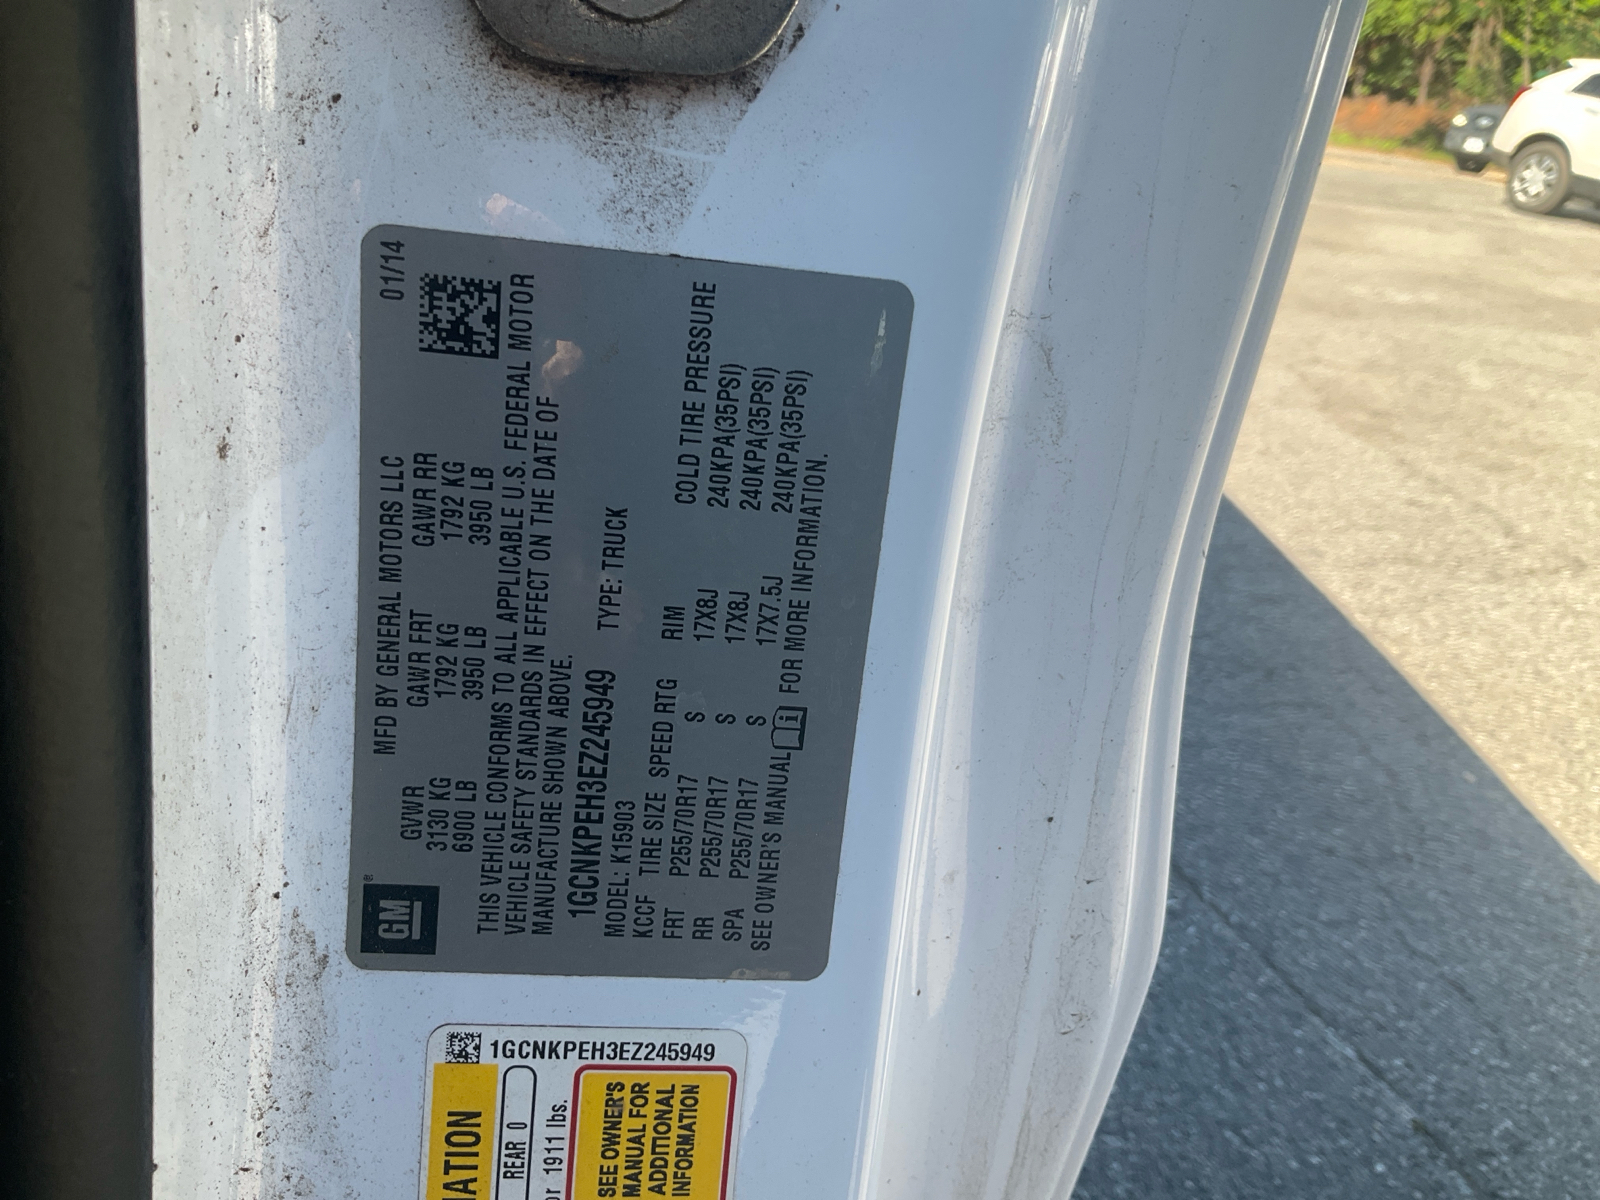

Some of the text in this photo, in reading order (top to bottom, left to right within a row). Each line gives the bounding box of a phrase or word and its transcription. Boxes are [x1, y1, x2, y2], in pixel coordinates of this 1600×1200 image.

[380, 241, 404, 300] 01/14
[675, 282, 716, 504] COLD TIRE PRESSURE
[412, 453, 437, 546] GAWR RR
[440, 462, 465, 540] 1792 KG
[468, 467, 493, 545] 3950 LB
[693, 364, 747, 641] 17X8J 240KPA(35PSI)
[725, 367, 780, 643] 17X8J 240KPA(35PSI)
[756, 370, 813, 645] 17X7.5J 240KPA(35PSI)
[373, 456, 404, 754] MFD BY GENERAL MOTORS LLC
[477, 274, 534, 934] THIS VEHICLE CONFORMS TO ALL APPLICABLE U.S. FEDERAL MOTOR
[597, 507, 628, 630] TYPE: TRUCK
[407, 609, 432, 707] GAWR FRT
[434, 624, 459, 698] 1792 KG
[462, 626, 486, 700] 3950 LB
[505, 396, 559, 935] VEHICLE SAFETY STANDARDS IN EFFECT ON THE DATE OF
[751, 455, 828, 950] SEE OWNER'S MANUAL FOR MORE INFORMATION.
[400, 786, 424, 840] GVWR
[426, 778, 451, 851] 3130 KG
[452, 781, 477, 852] 6900 LB
[532, 655, 572, 934] MANUFACTURE SHOWN ABOVE.
[567, 670, 616, 917] 1GCNKPEH3EZ245949
[633, 606, 685, 938] KCCF TIRE SIZE SPEED RTG RIM
[662, 712, 705, 938] FRT P255/70R17 S
[692, 714, 736, 939] RR P255/70R17 S
[722, 716, 766, 941] SPA P255/70R17 S
[378, 899, 410, 940] GM
[604, 801, 635, 937] MODEL: K15903
[490, 1039, 716, 1062] 1GCNKPEH3EZ245949
[441, 1110, 483, 1200] ATION
[502, 1141, 527, 1180] REAR
[542, 1136, 565, 1175] 1911
[545, 1100, 568, 1128] lbs.
[597, 1081, 625, 1198] SEE OWNER'S
[621, 1081, 651, 1197] MANUAL FOR
[647, 1083, 676, 1196] ADDITIONAL
[671, 1084, 700, 1197] INFORMATION
